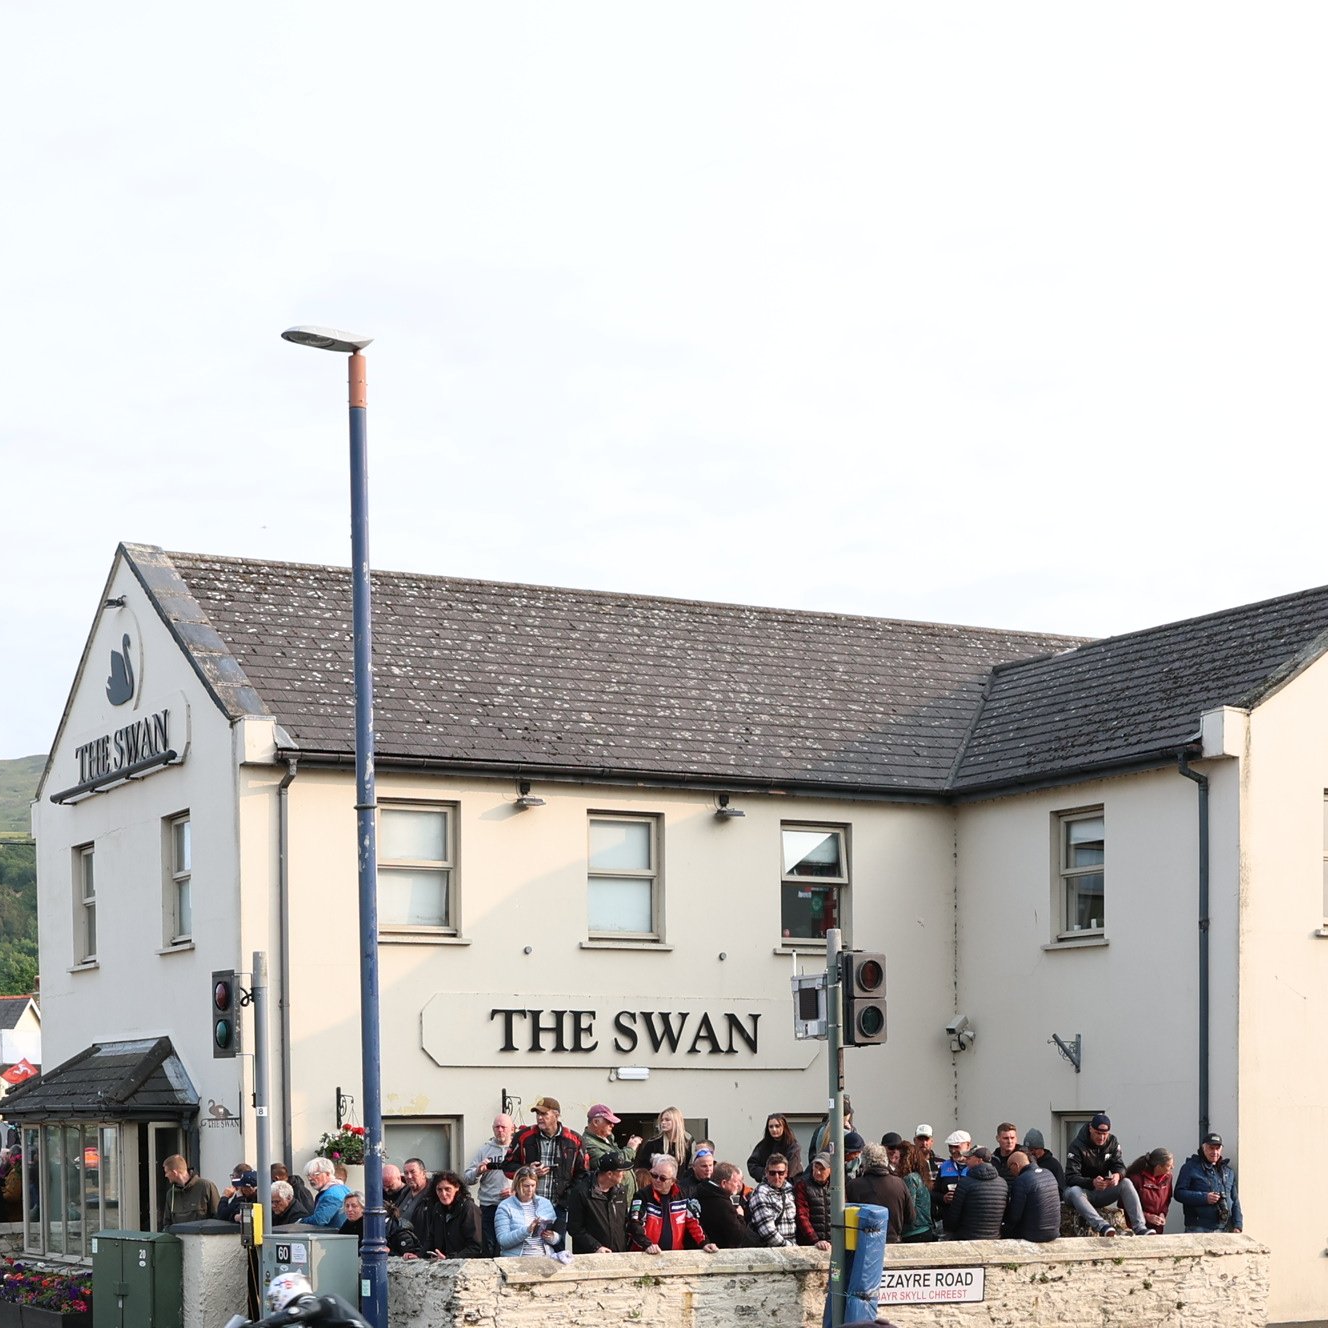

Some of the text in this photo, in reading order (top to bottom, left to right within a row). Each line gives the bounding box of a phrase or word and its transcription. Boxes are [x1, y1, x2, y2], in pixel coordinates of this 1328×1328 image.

[75, 709, 170, 785] THE SWAN
[490, 1008, 762, 1055] THE SWAN
[139, 1249, 146, 1259] 20
[278, 1246, 289, 1260] 60
[880, 1272, 973, 1288] EZAYRE ROAD
[899, 1290, 927, 1300] SKYLL
[928, 1289, 968, 1300] CHREEST
